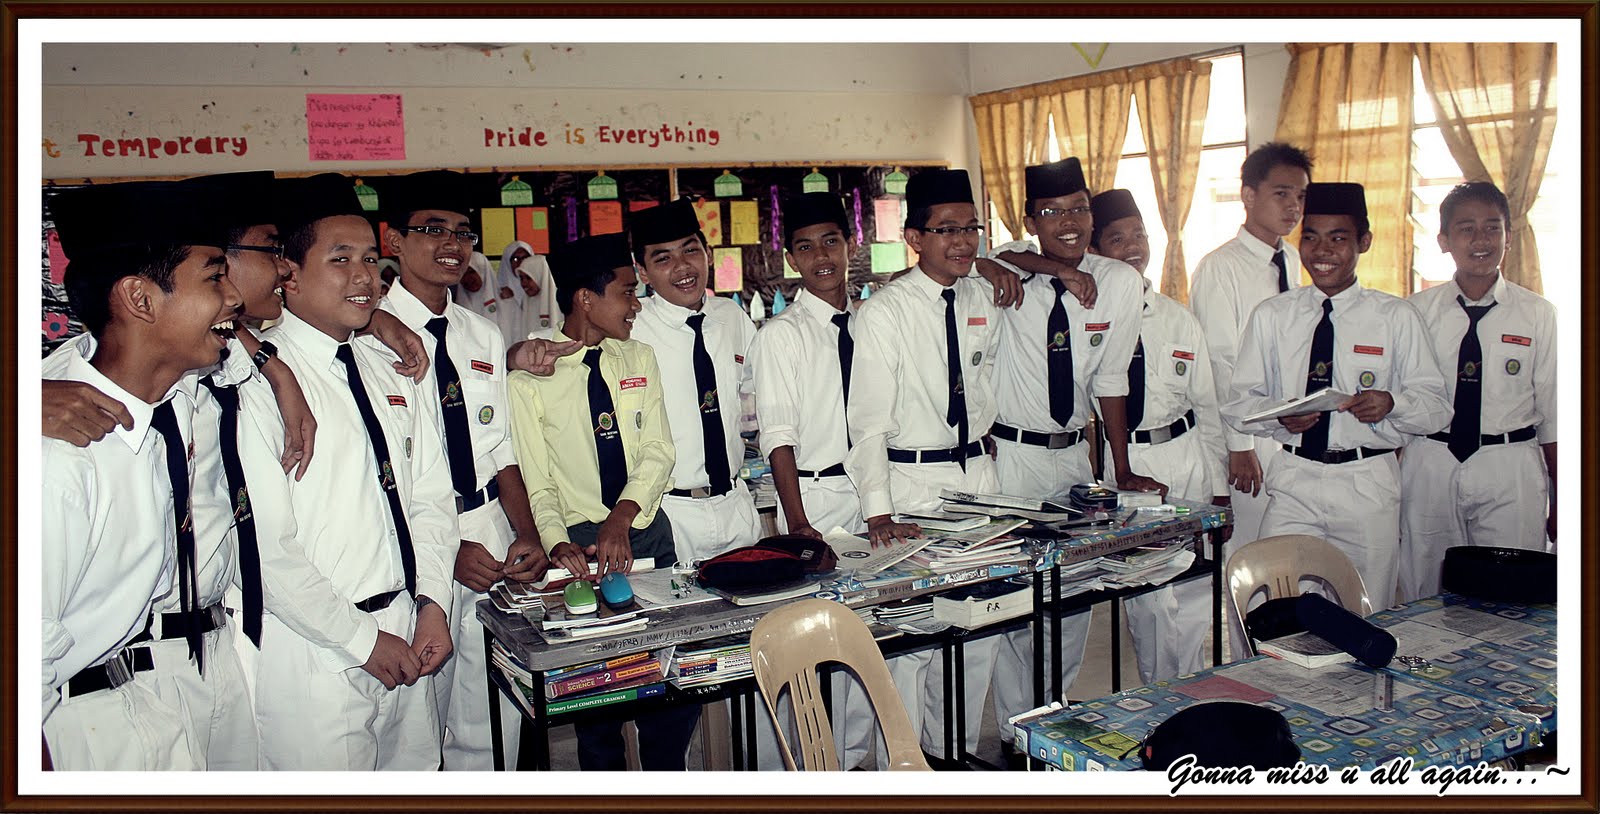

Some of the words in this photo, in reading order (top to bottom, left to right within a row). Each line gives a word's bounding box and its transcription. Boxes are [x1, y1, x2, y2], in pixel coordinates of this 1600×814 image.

[484, 127, 548, 147] Pride
[565, 123, 585, 145] is
[599, 121, 720, 148] Everything
[77, 133, 248, 159] Temporary
[604, 672, 612, 682] 2
[567, 681, 596, 692] SCIENCE
[548, 705, 566, 713] Primary
[567, 702, 579, 710] Level
[578, 699, 603, 708] COMPLETE
[603, 695, 626, 703] GRAMMAR
